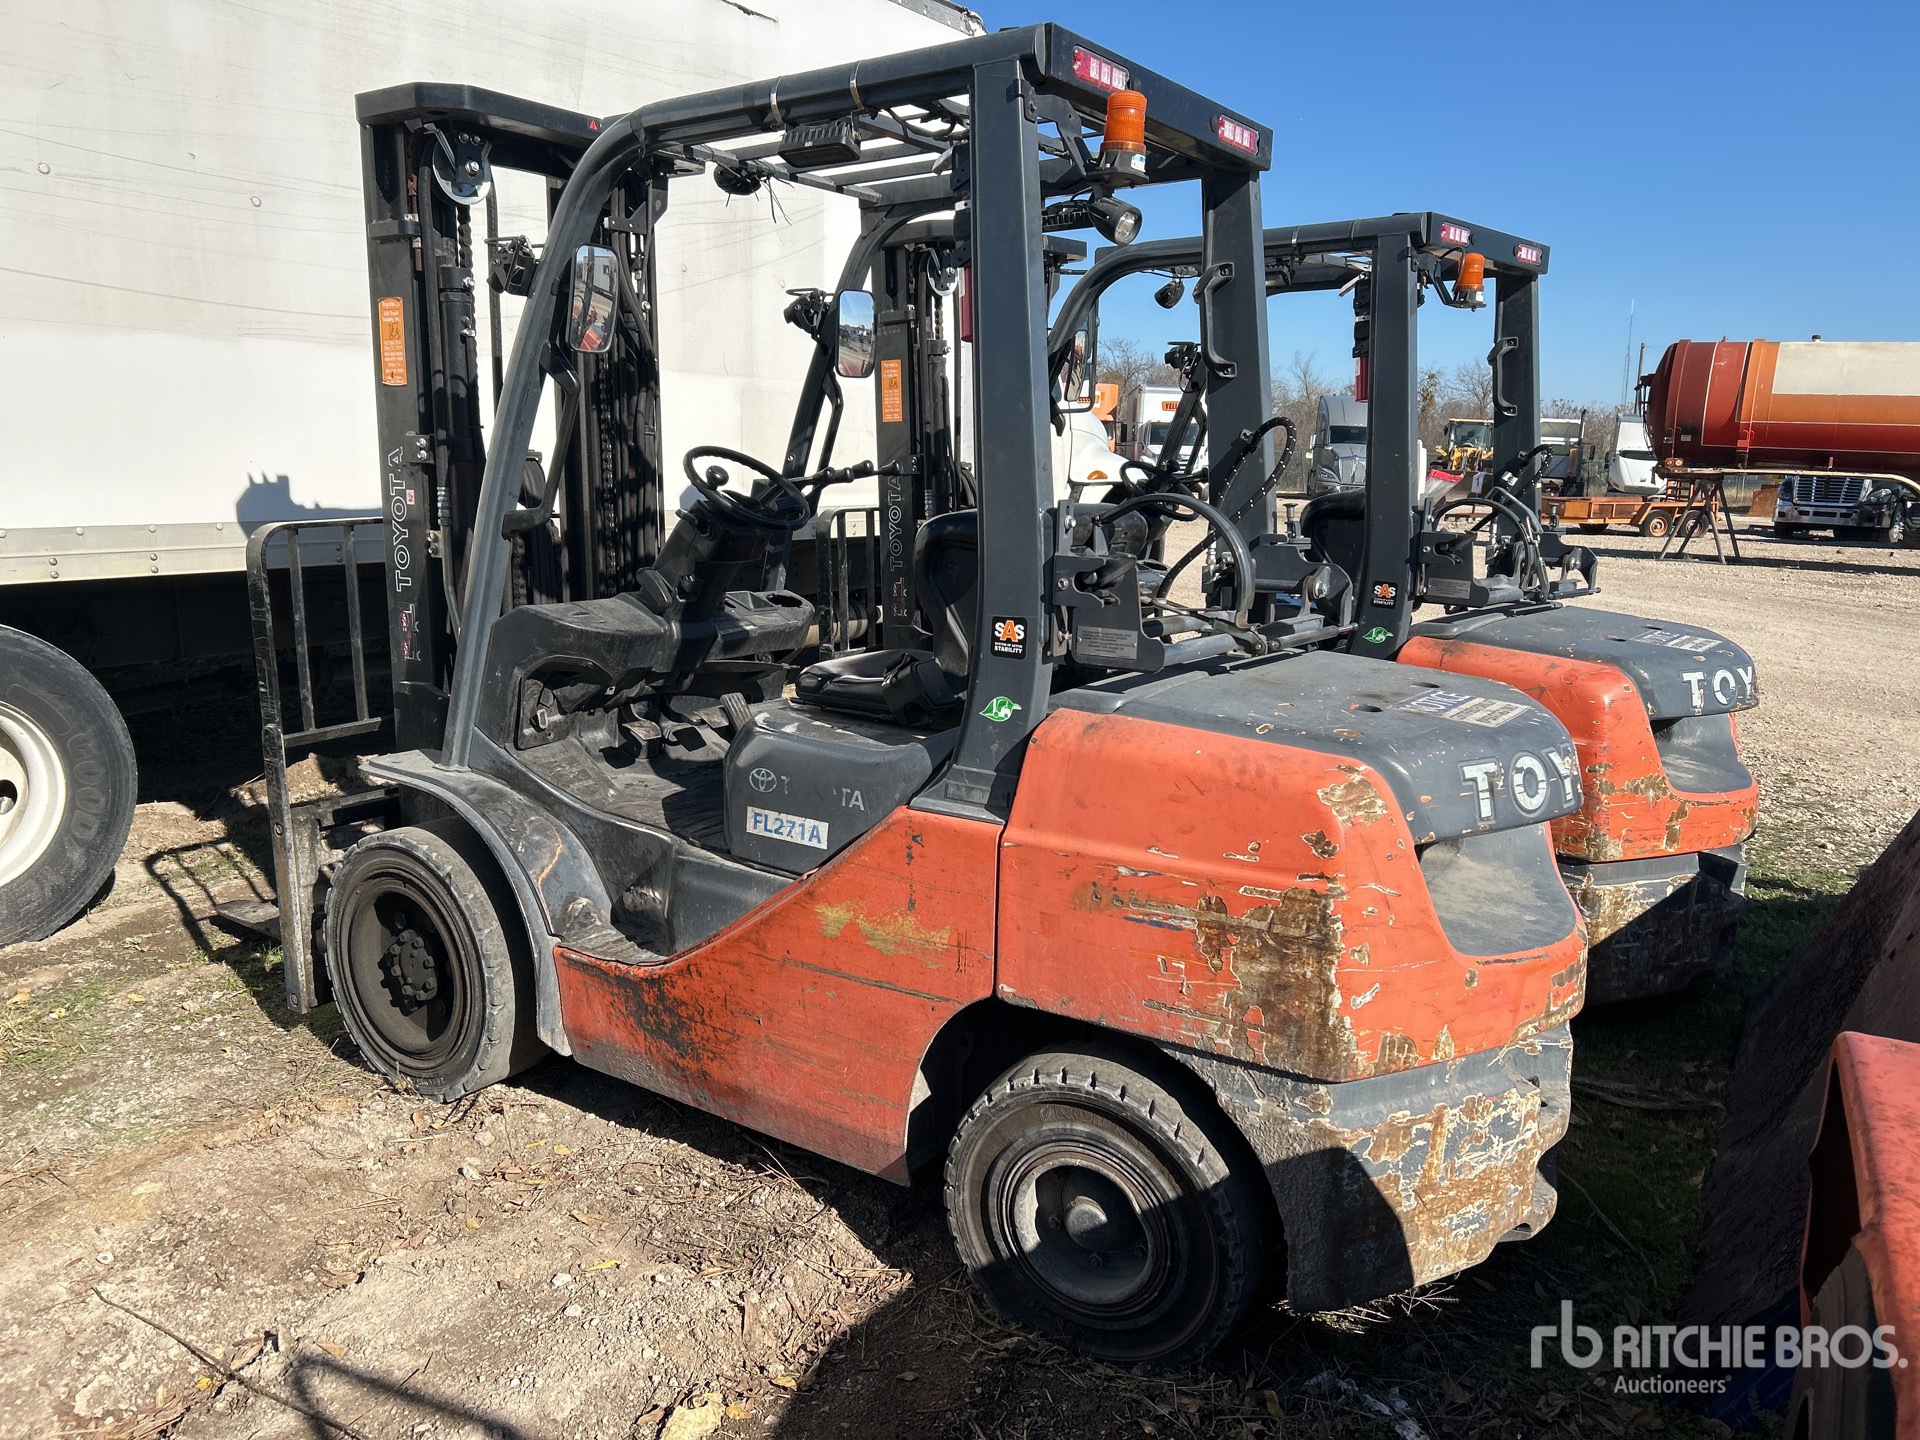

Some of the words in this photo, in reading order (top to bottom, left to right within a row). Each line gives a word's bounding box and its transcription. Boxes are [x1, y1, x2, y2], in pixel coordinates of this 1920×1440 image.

[387, 446, 412, 592] TOYOTA
[887, 475, 904, 572] TOYOTA
[1374, 583, 1396, 598] SAS
[994, 620, 1025, 642] SAS
[994, 646, 1023, 654] STABILITY
[1681, 665, 1754, 708] TOY
[1460, 745, 1579, 821] TOY
[752, 811, 822, 844] FL271A
